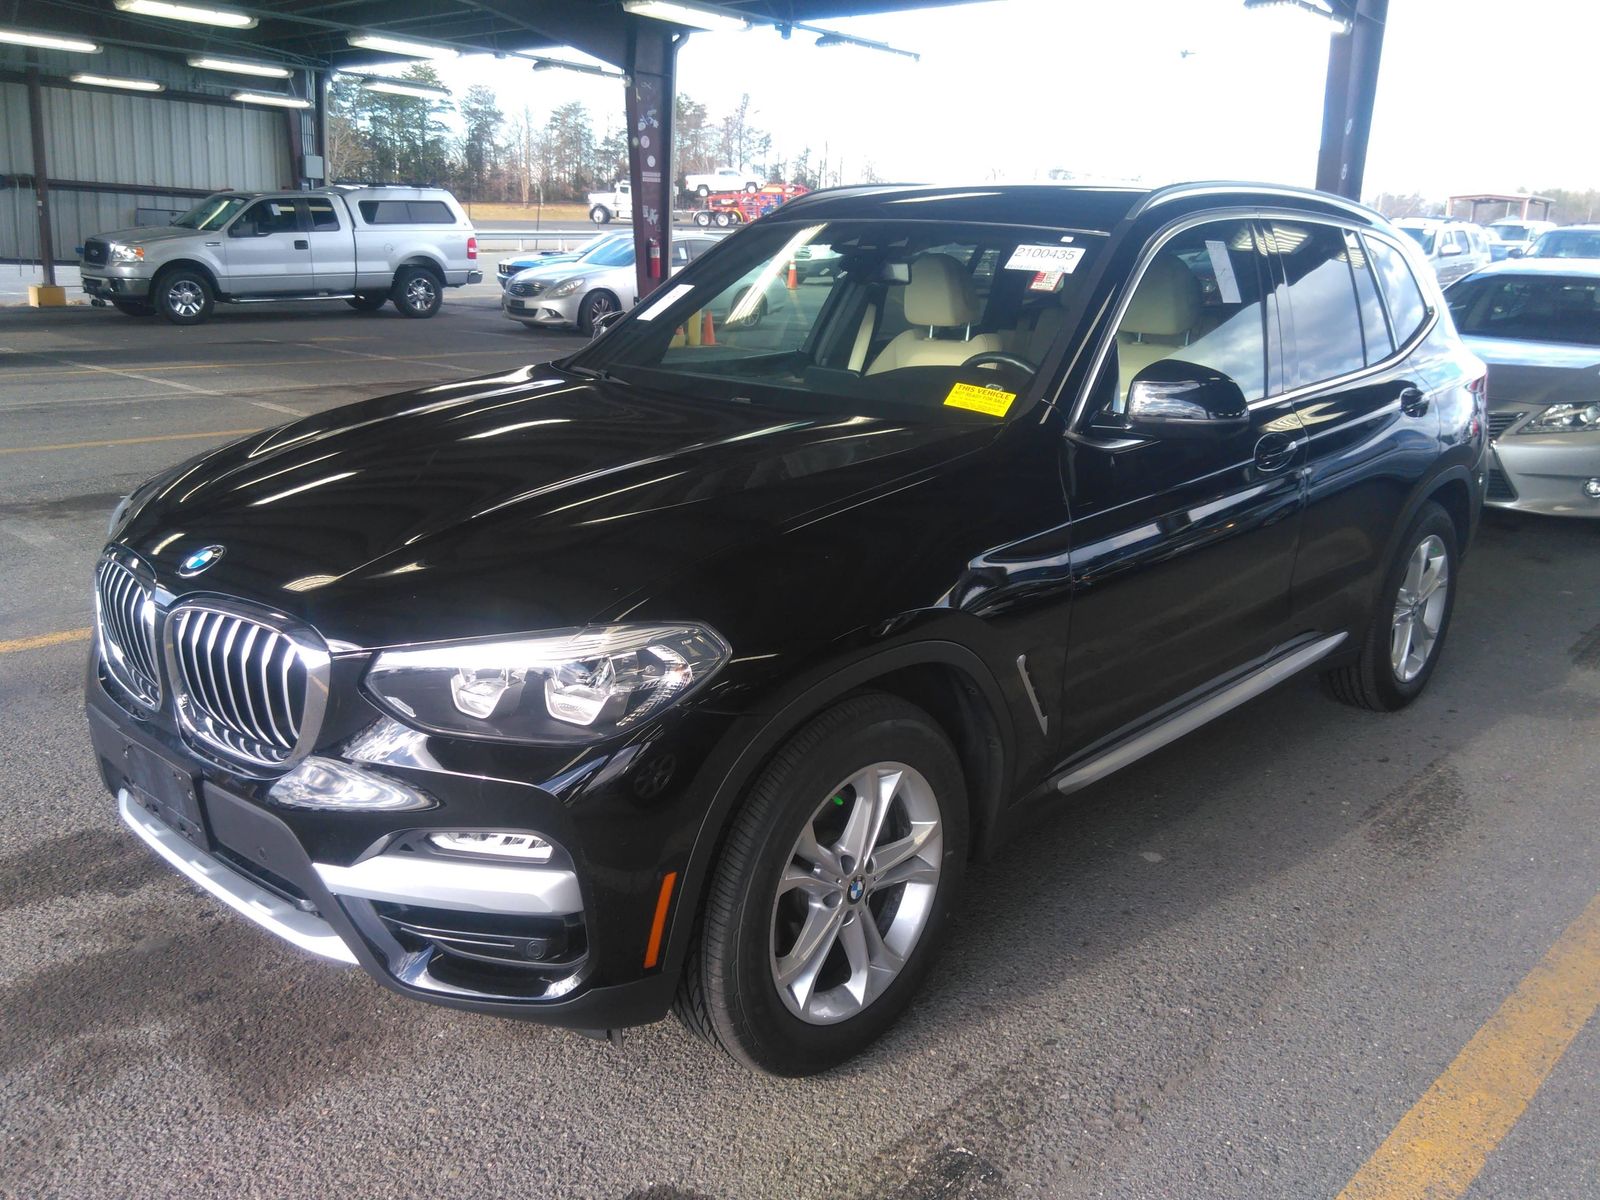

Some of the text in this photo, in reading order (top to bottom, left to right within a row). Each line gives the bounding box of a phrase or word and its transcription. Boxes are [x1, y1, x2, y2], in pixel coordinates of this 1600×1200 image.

[1014, 247, 1075, 260] 2100435
[958, 384, 1011, 400] THIS VEHICLE
